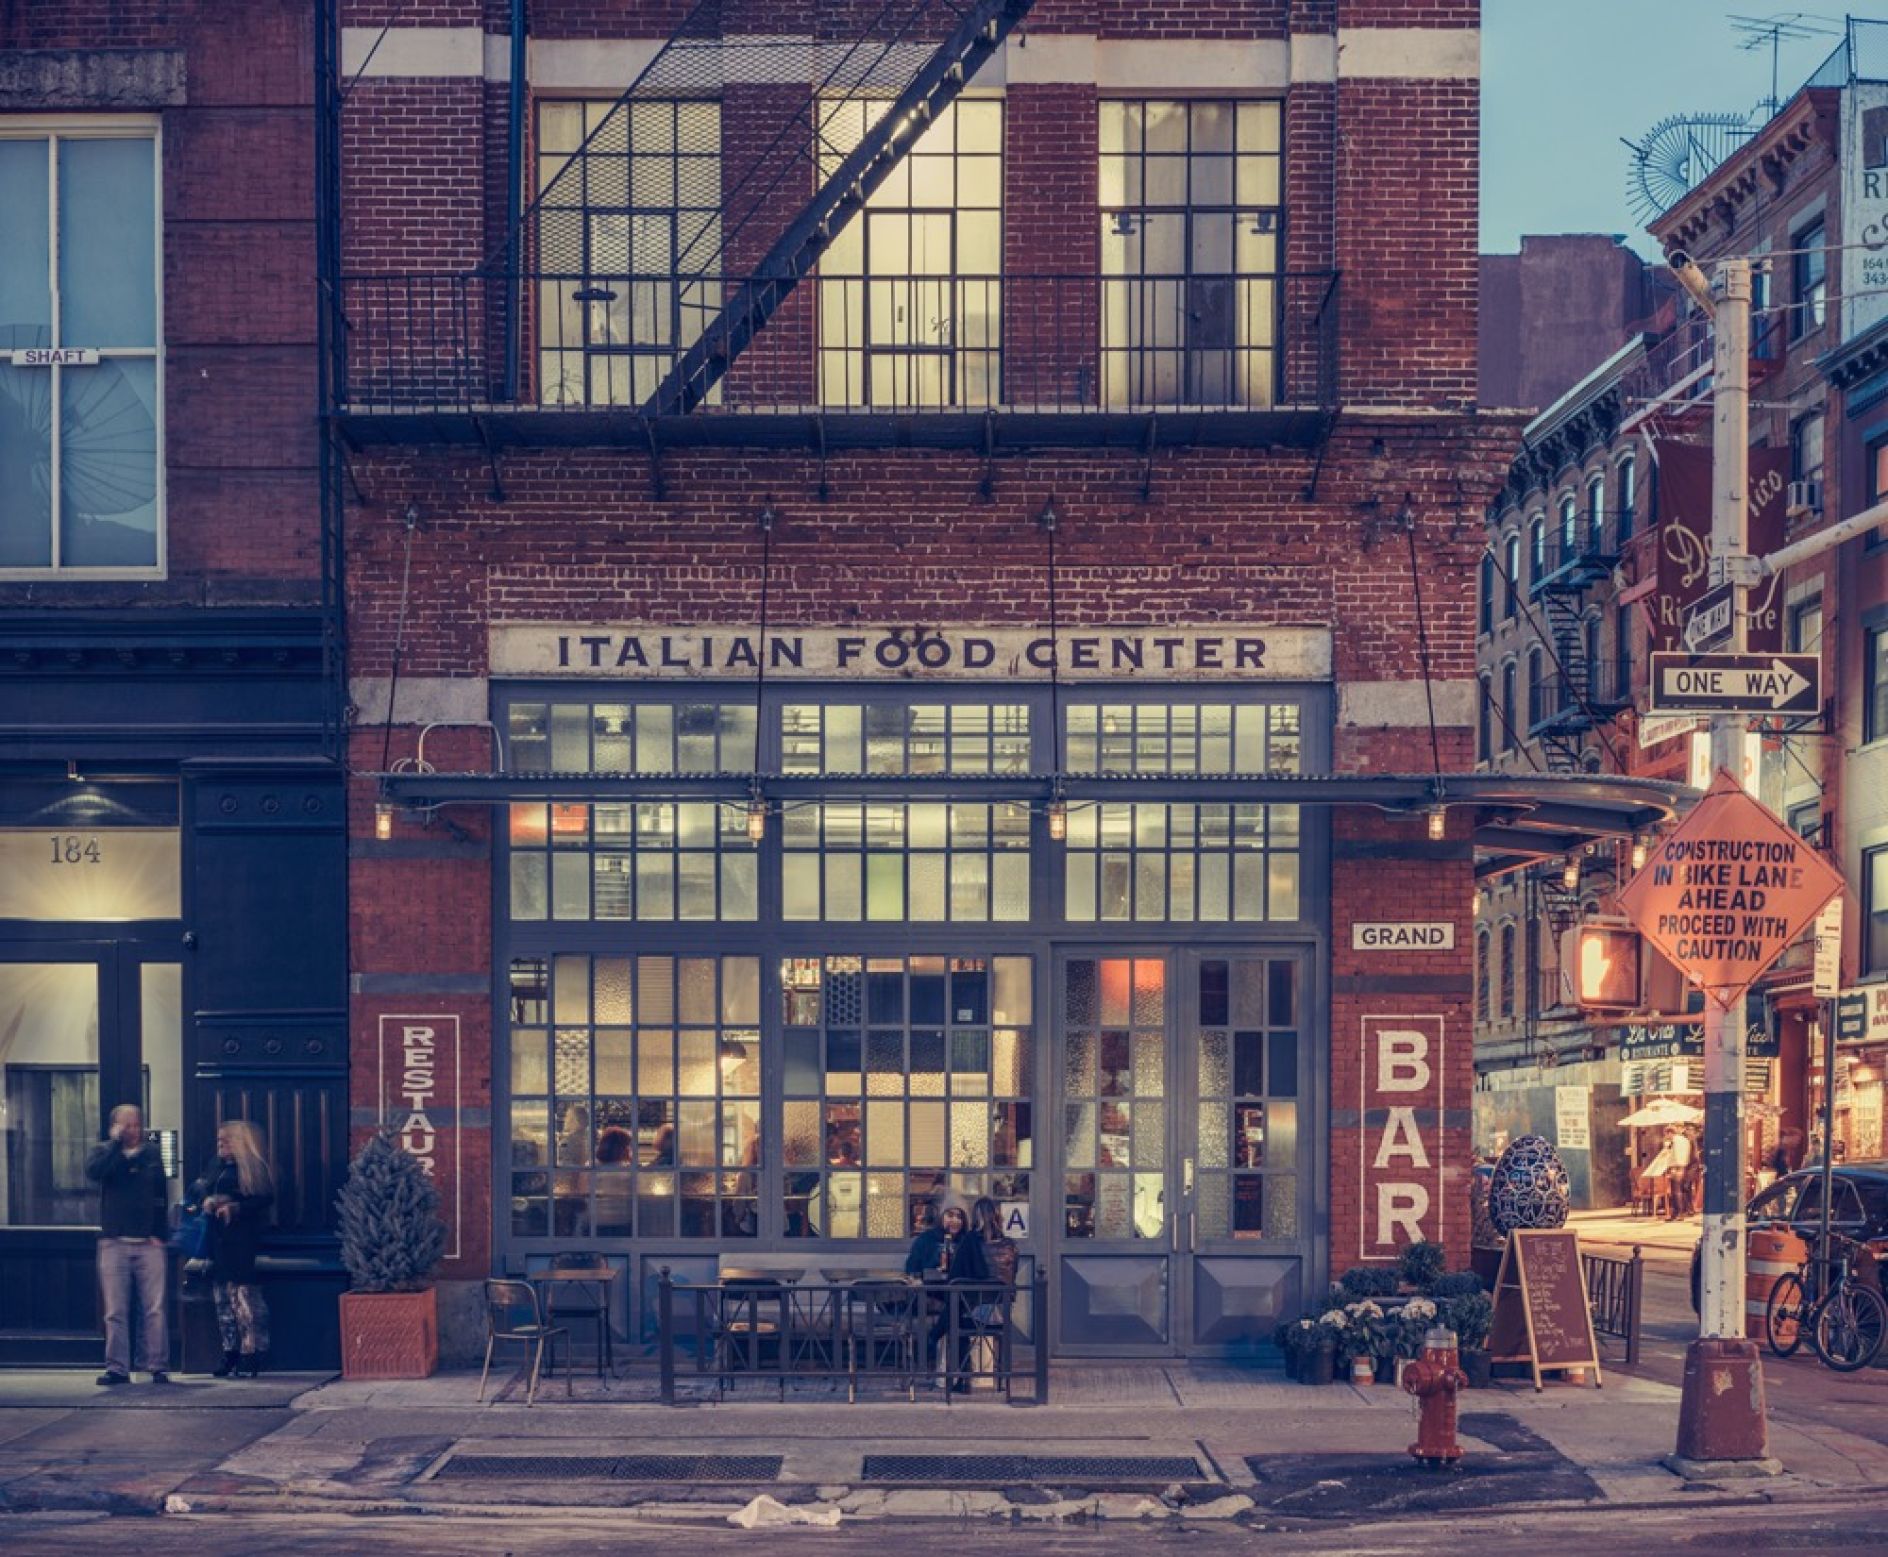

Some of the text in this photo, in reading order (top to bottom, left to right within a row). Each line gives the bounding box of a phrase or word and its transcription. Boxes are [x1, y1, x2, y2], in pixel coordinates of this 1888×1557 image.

[25, 350, 86, 363] SHAFT
[558, 636, 1266, 669] ITALIAN FOOD CENTER
[1676, 671, 1794, 695] ONE WAY
[50, 835, 101, 864] 184
[1665, 840, 1796, 863] CONSTRUCTION
[1654, 864, 1803, 889] IN BIKE LANE
[1678, 889, 1766, 911] AHEAD
[1361, 927, 1445, 946] GRAND
[1658, 914, 1788, 938] PROCEED WITH
[1678, 939, 1762, 961] CAUTION
[1372, 1029, 1431, 1245] BAR
[1006, 1207, 1026, 1232] A
